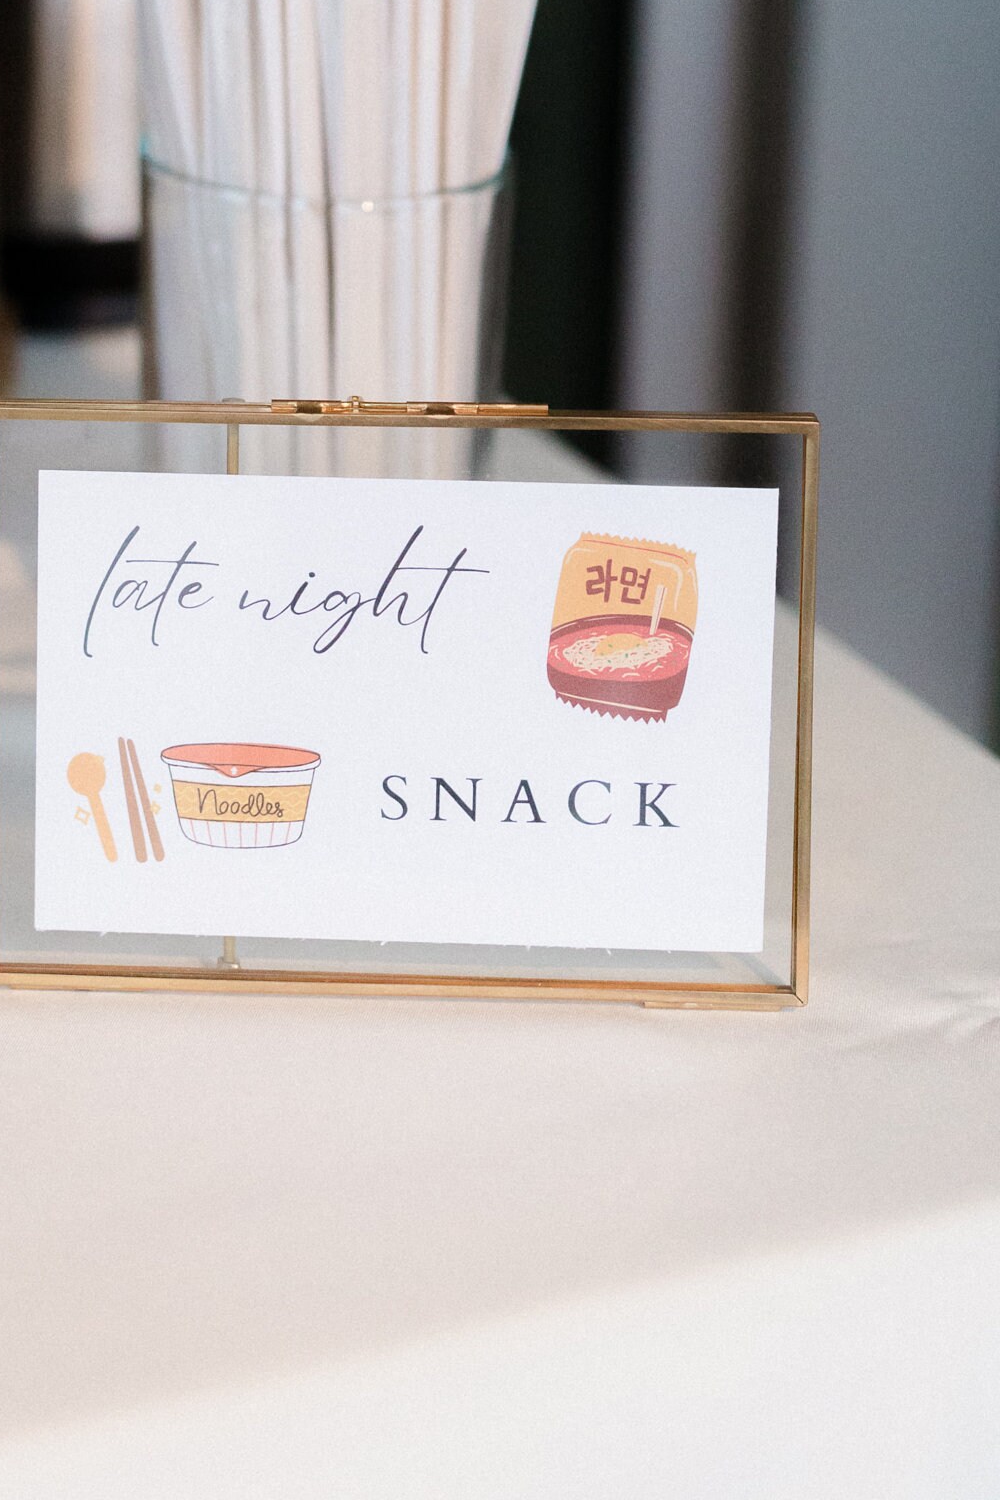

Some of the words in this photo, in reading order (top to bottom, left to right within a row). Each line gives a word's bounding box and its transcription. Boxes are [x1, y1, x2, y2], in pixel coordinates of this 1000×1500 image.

[83, 524, 220, 658] late
[238, 524, 491, 655] night
[585, 558, 652, 605] 라면
[196, 786, 285, 818] Noodles
[379, 774, 681, 830] SNACK
